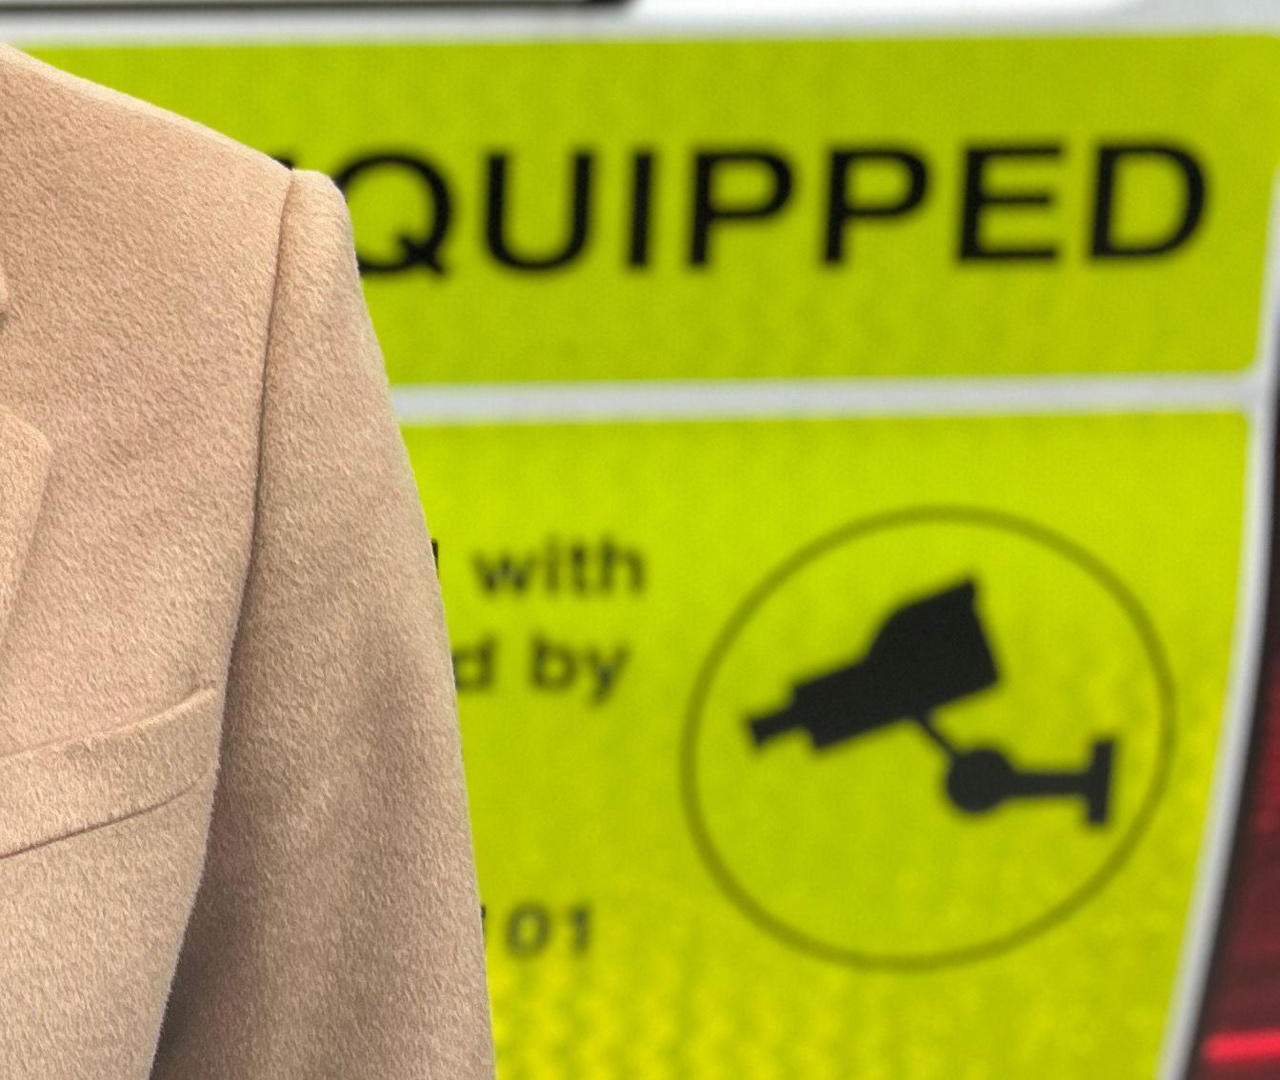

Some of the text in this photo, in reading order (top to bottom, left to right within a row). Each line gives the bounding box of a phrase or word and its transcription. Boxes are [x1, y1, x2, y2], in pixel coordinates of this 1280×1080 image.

[272, 140, 1208, 278] QUIPPED
[471, 537, 647, 599] with
[531, 631, 629, 710] by
[481, 902, 594, 958] 01
